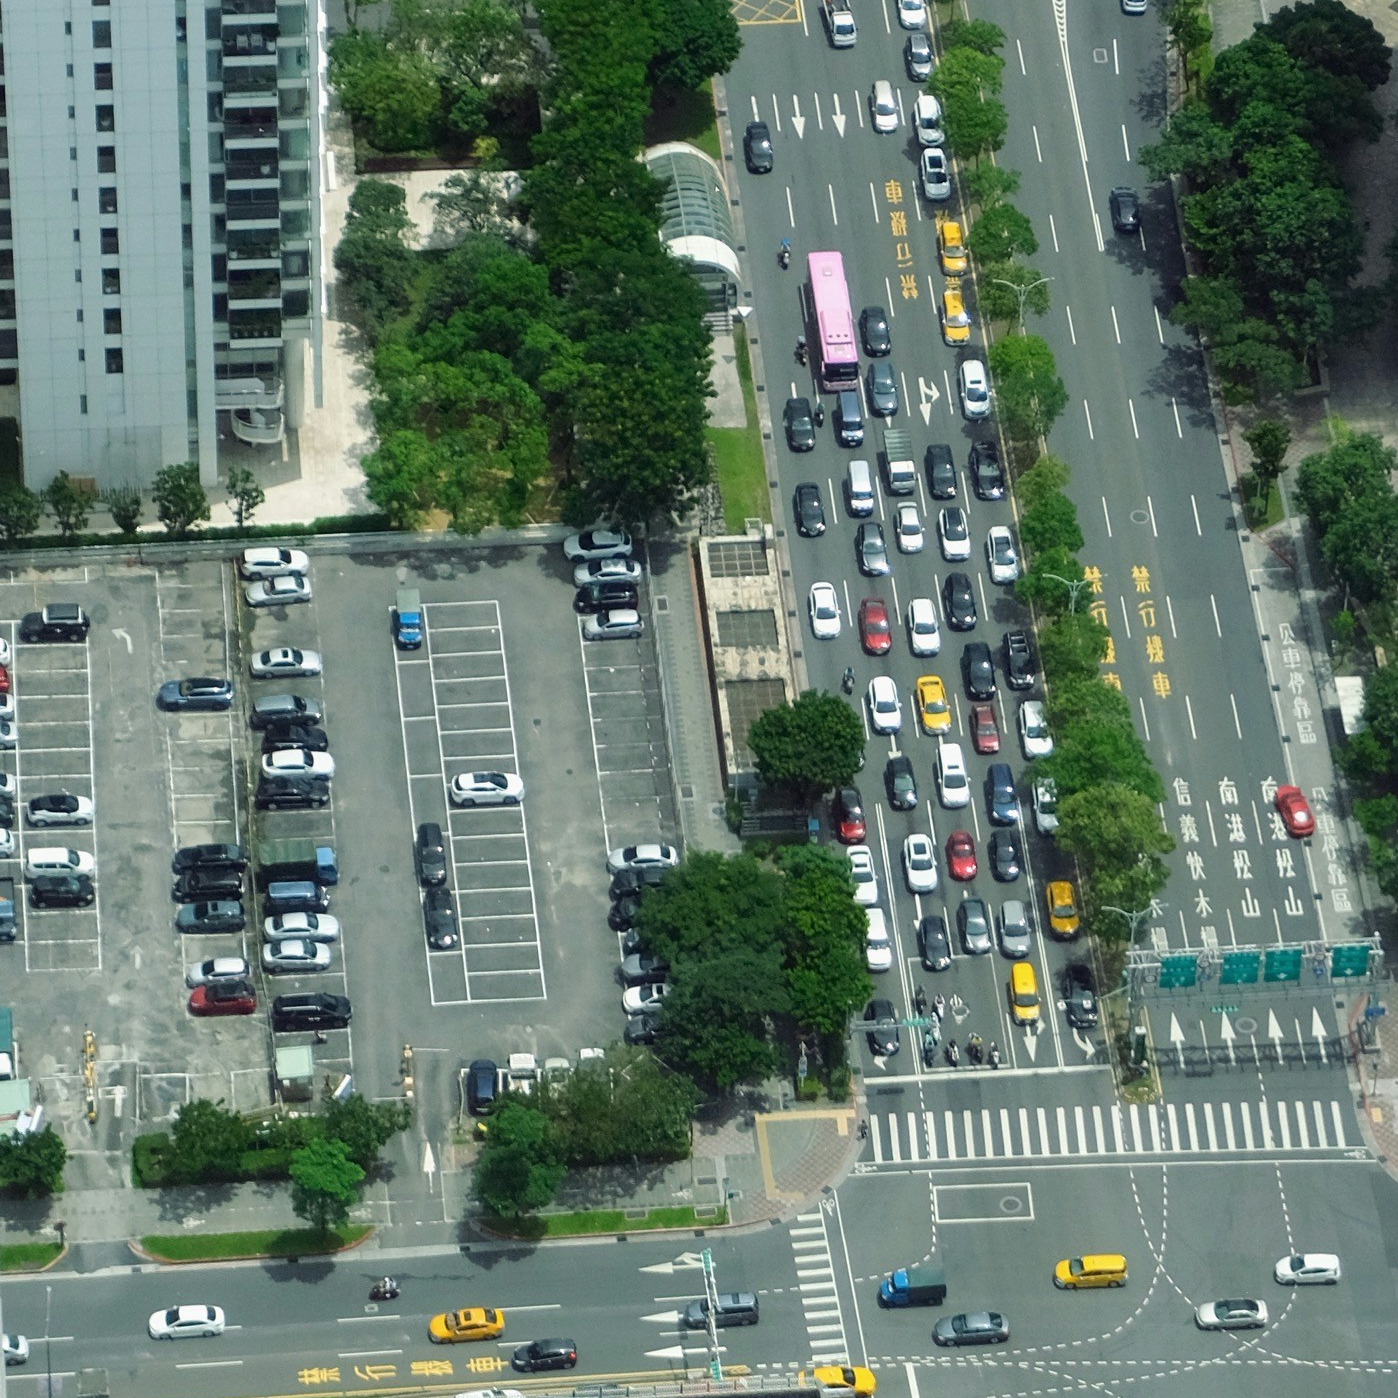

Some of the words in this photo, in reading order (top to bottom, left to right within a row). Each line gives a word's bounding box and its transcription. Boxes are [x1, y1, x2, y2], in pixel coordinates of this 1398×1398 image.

[884, 179, 919, 300] 禁行機車
[1131, 564, 1172, 699] 禁行機車
[1278, 622, 1317, 745] 公車停靠區
[1218, 776, 1261, 918] 南港松山
[1311, 786, 1353, 914] 公車停靠區
[297, 1356, 511, 1386] 禁行機車
